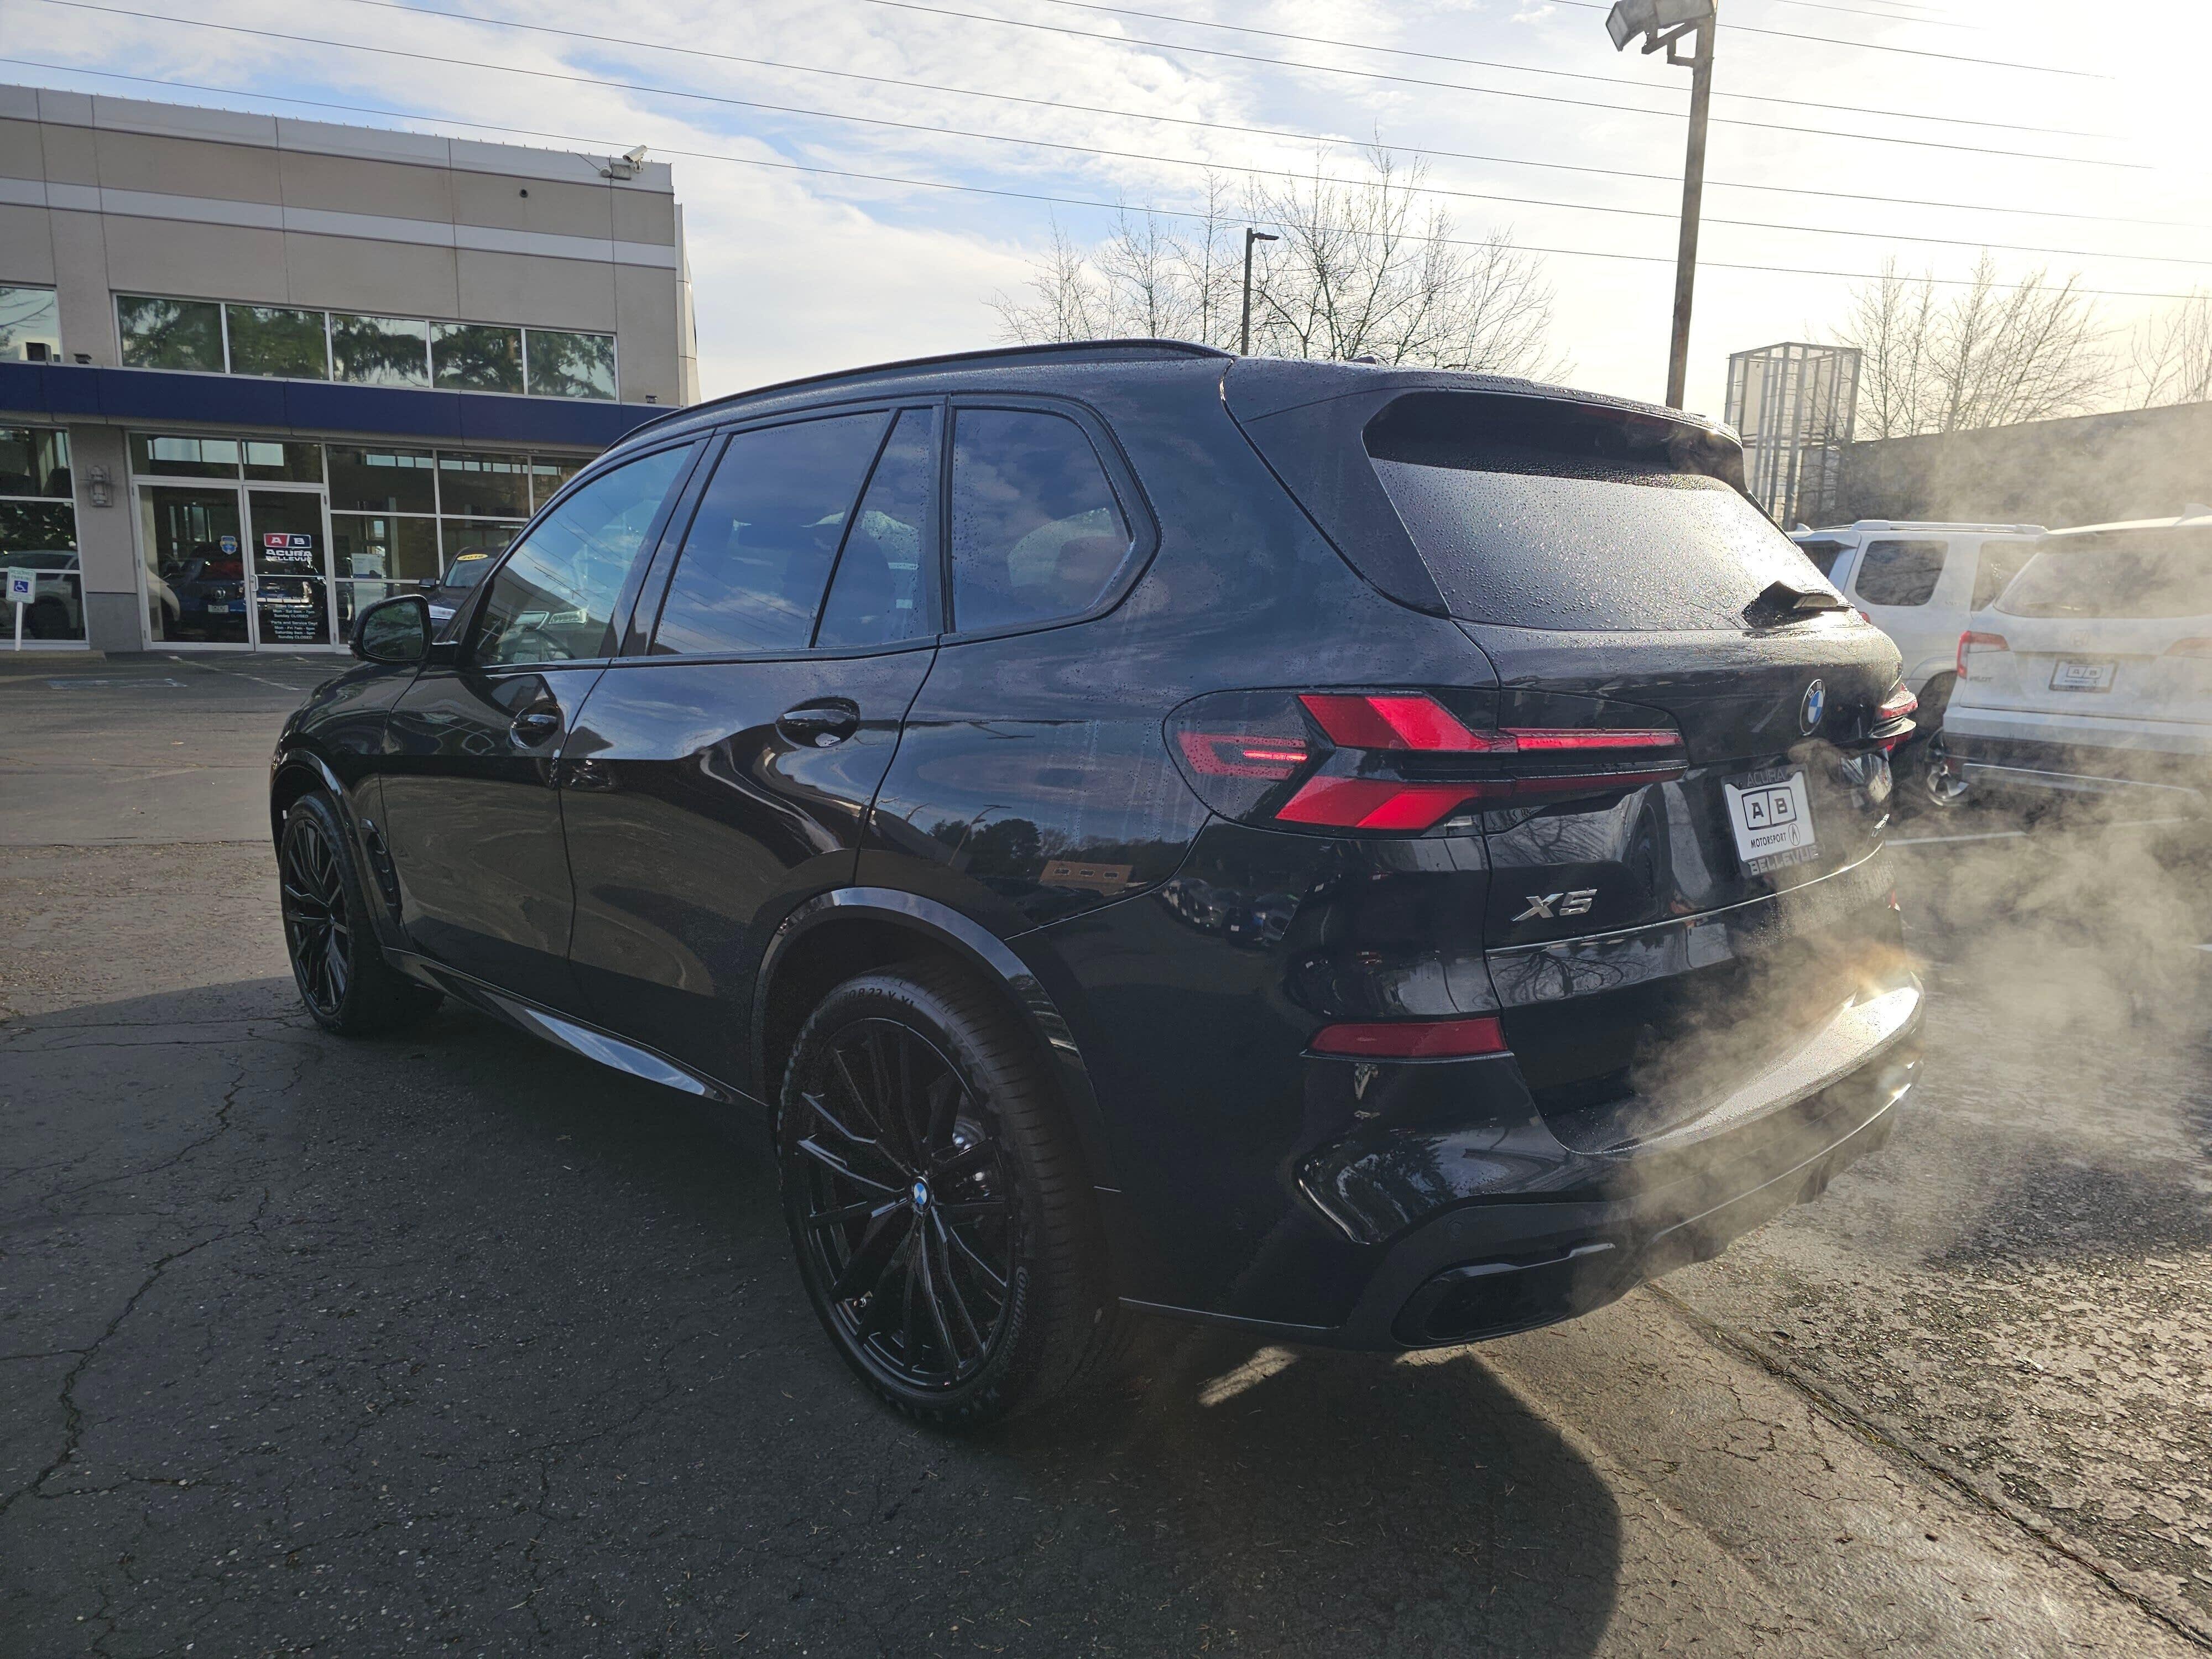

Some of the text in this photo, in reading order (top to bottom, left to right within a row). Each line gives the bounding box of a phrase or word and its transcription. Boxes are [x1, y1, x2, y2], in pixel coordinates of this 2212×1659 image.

[265, 549, 312, 557] ACURA
[1747, 769, 1785, 787] ACURA
[1751, 797, 1788, 819] A B
[1751, 832, 1786, 849] MOTORSPORT
[1749, 844, 1818, 876] BELLEVUE
[1511, 889, 1598, 922] X5
[999, 1266, 1028, 1361] Continent
